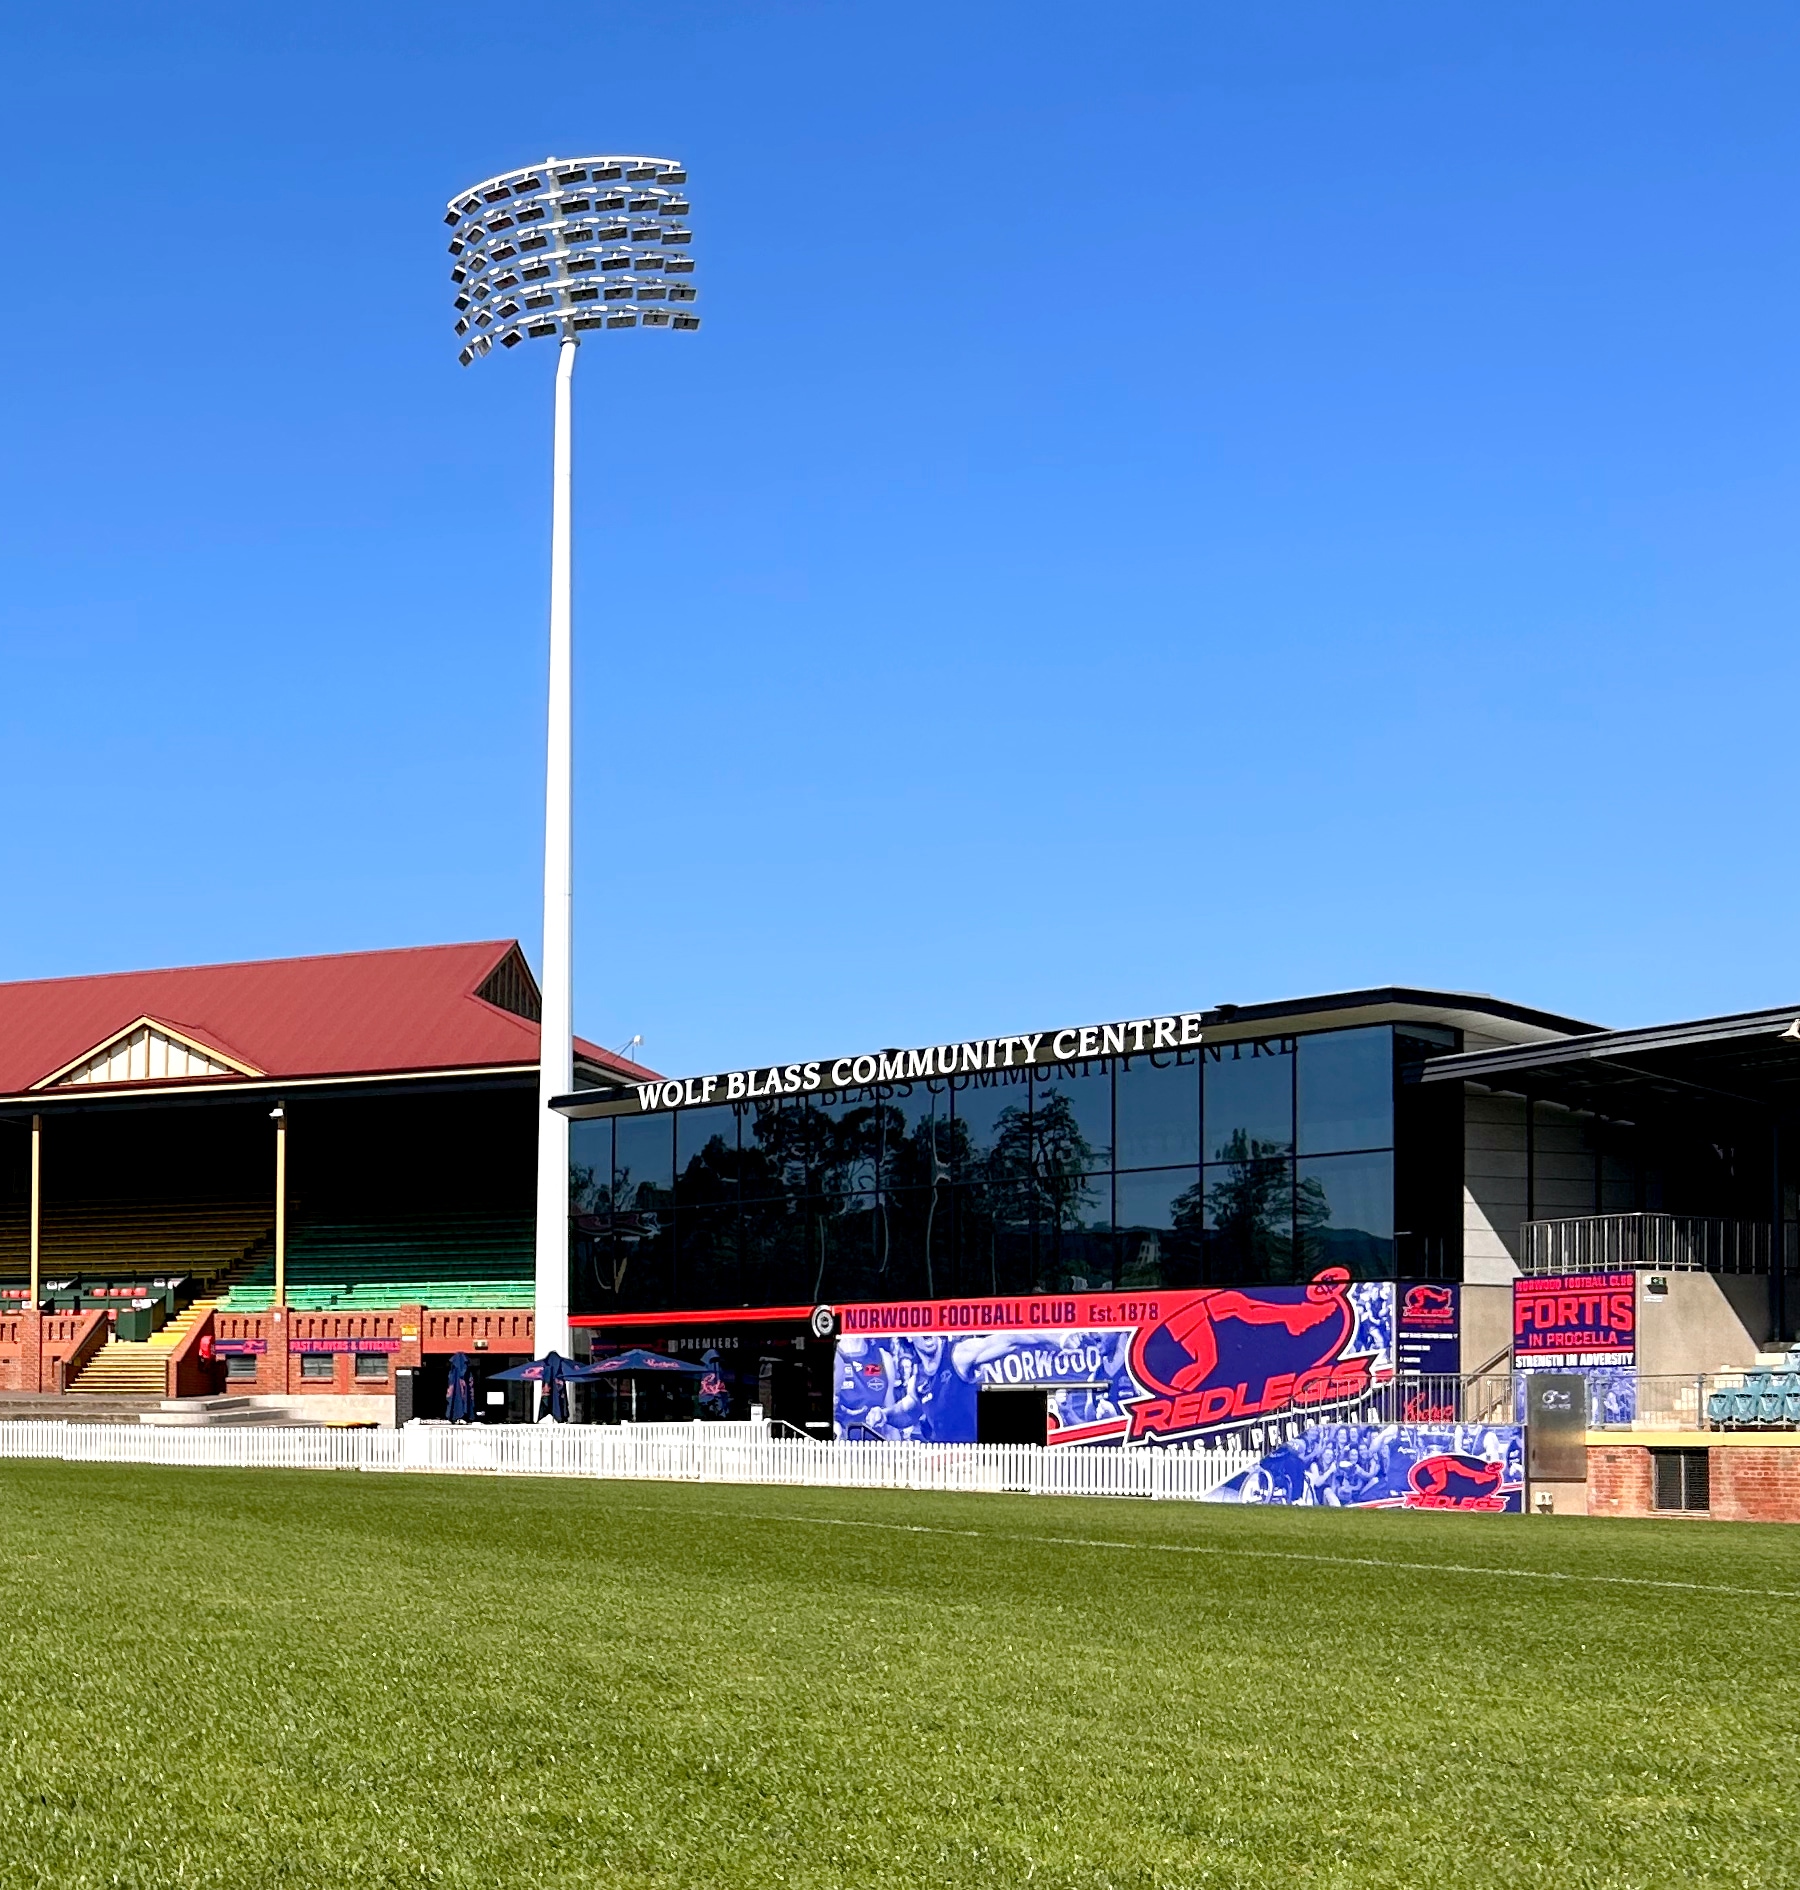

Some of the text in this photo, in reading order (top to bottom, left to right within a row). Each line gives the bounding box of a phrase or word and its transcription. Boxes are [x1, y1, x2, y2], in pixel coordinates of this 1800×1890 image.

[637, 1013, 1202, 1110] WOLF BLASS COMMUNITY CENTRE
[1609, 1274, 1634, 1287] CLUB
[845, 1307, 933, 1330] NORWOOD
[939, 1302, 1024, 1327] FOOTBALL
[1029, 1302, 1076, 1324] CLUB
[1515, 1294, 1633, 1335] FORTIS
[290, 1340, 312, 1351] PAST
[680, 1337, 739, 1349] PREMIERS
[1528, 1331, 1618, 1347] IN PROCELLA
[983, 1346, 1100, 1384] NORWOOD
[1515, 1352, 1634, 1368] STRENGTH IN ADVERSITY
[1131, 1358, 1369, 1437] REDLEGS
[1405, 1494, 1506, 1511] REDLEGS
